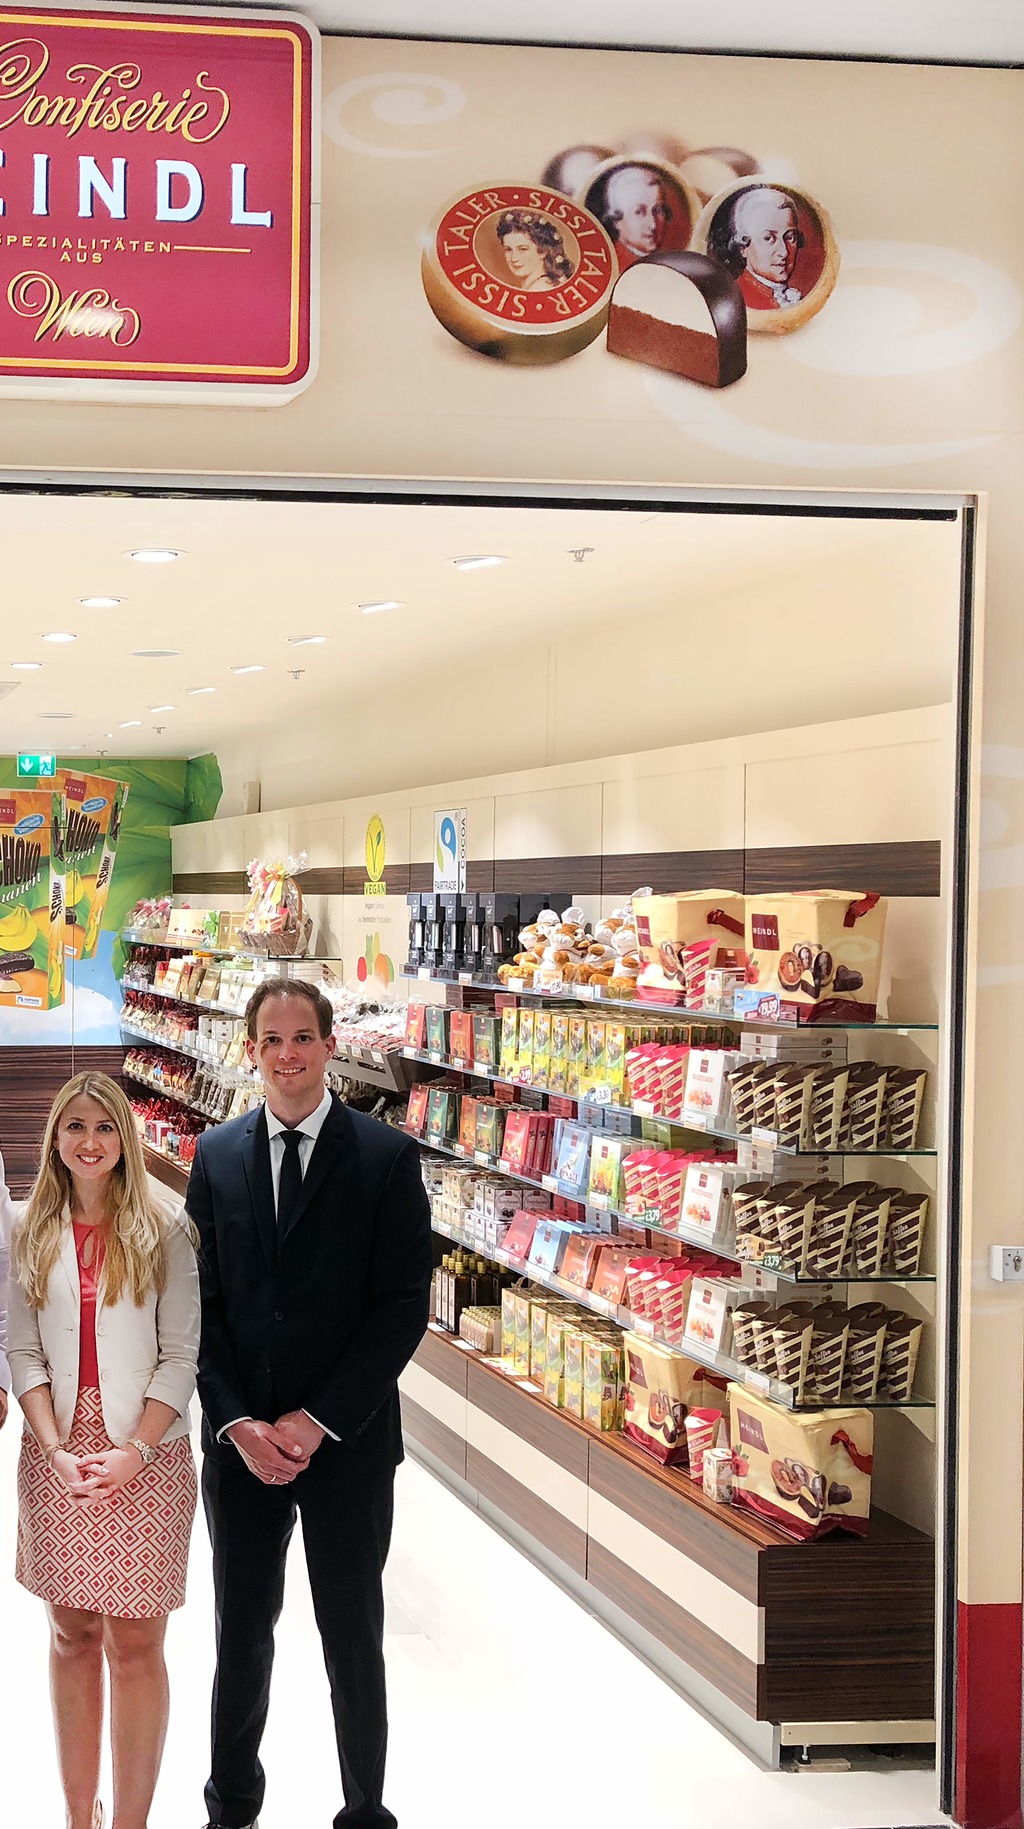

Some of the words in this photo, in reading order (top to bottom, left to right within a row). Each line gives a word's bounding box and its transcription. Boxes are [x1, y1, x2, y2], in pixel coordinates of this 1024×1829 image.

[444, 192, 506, 256] TALER
[529, 192, 596, 238] SISSI
[60, 251, 104, 264] AUS
[452, 262, 527, 317] SISSI
[547, 248, 607, 314] TALER
[6, 270, 141, 347] Wien
[365, 884, 386, 894] VEGAN
[435, 880, 457, 890] FAIRTRADE
[752, 927, 777, 936] HEINDL
[740, 1422, 763, 1440] HEINDL
